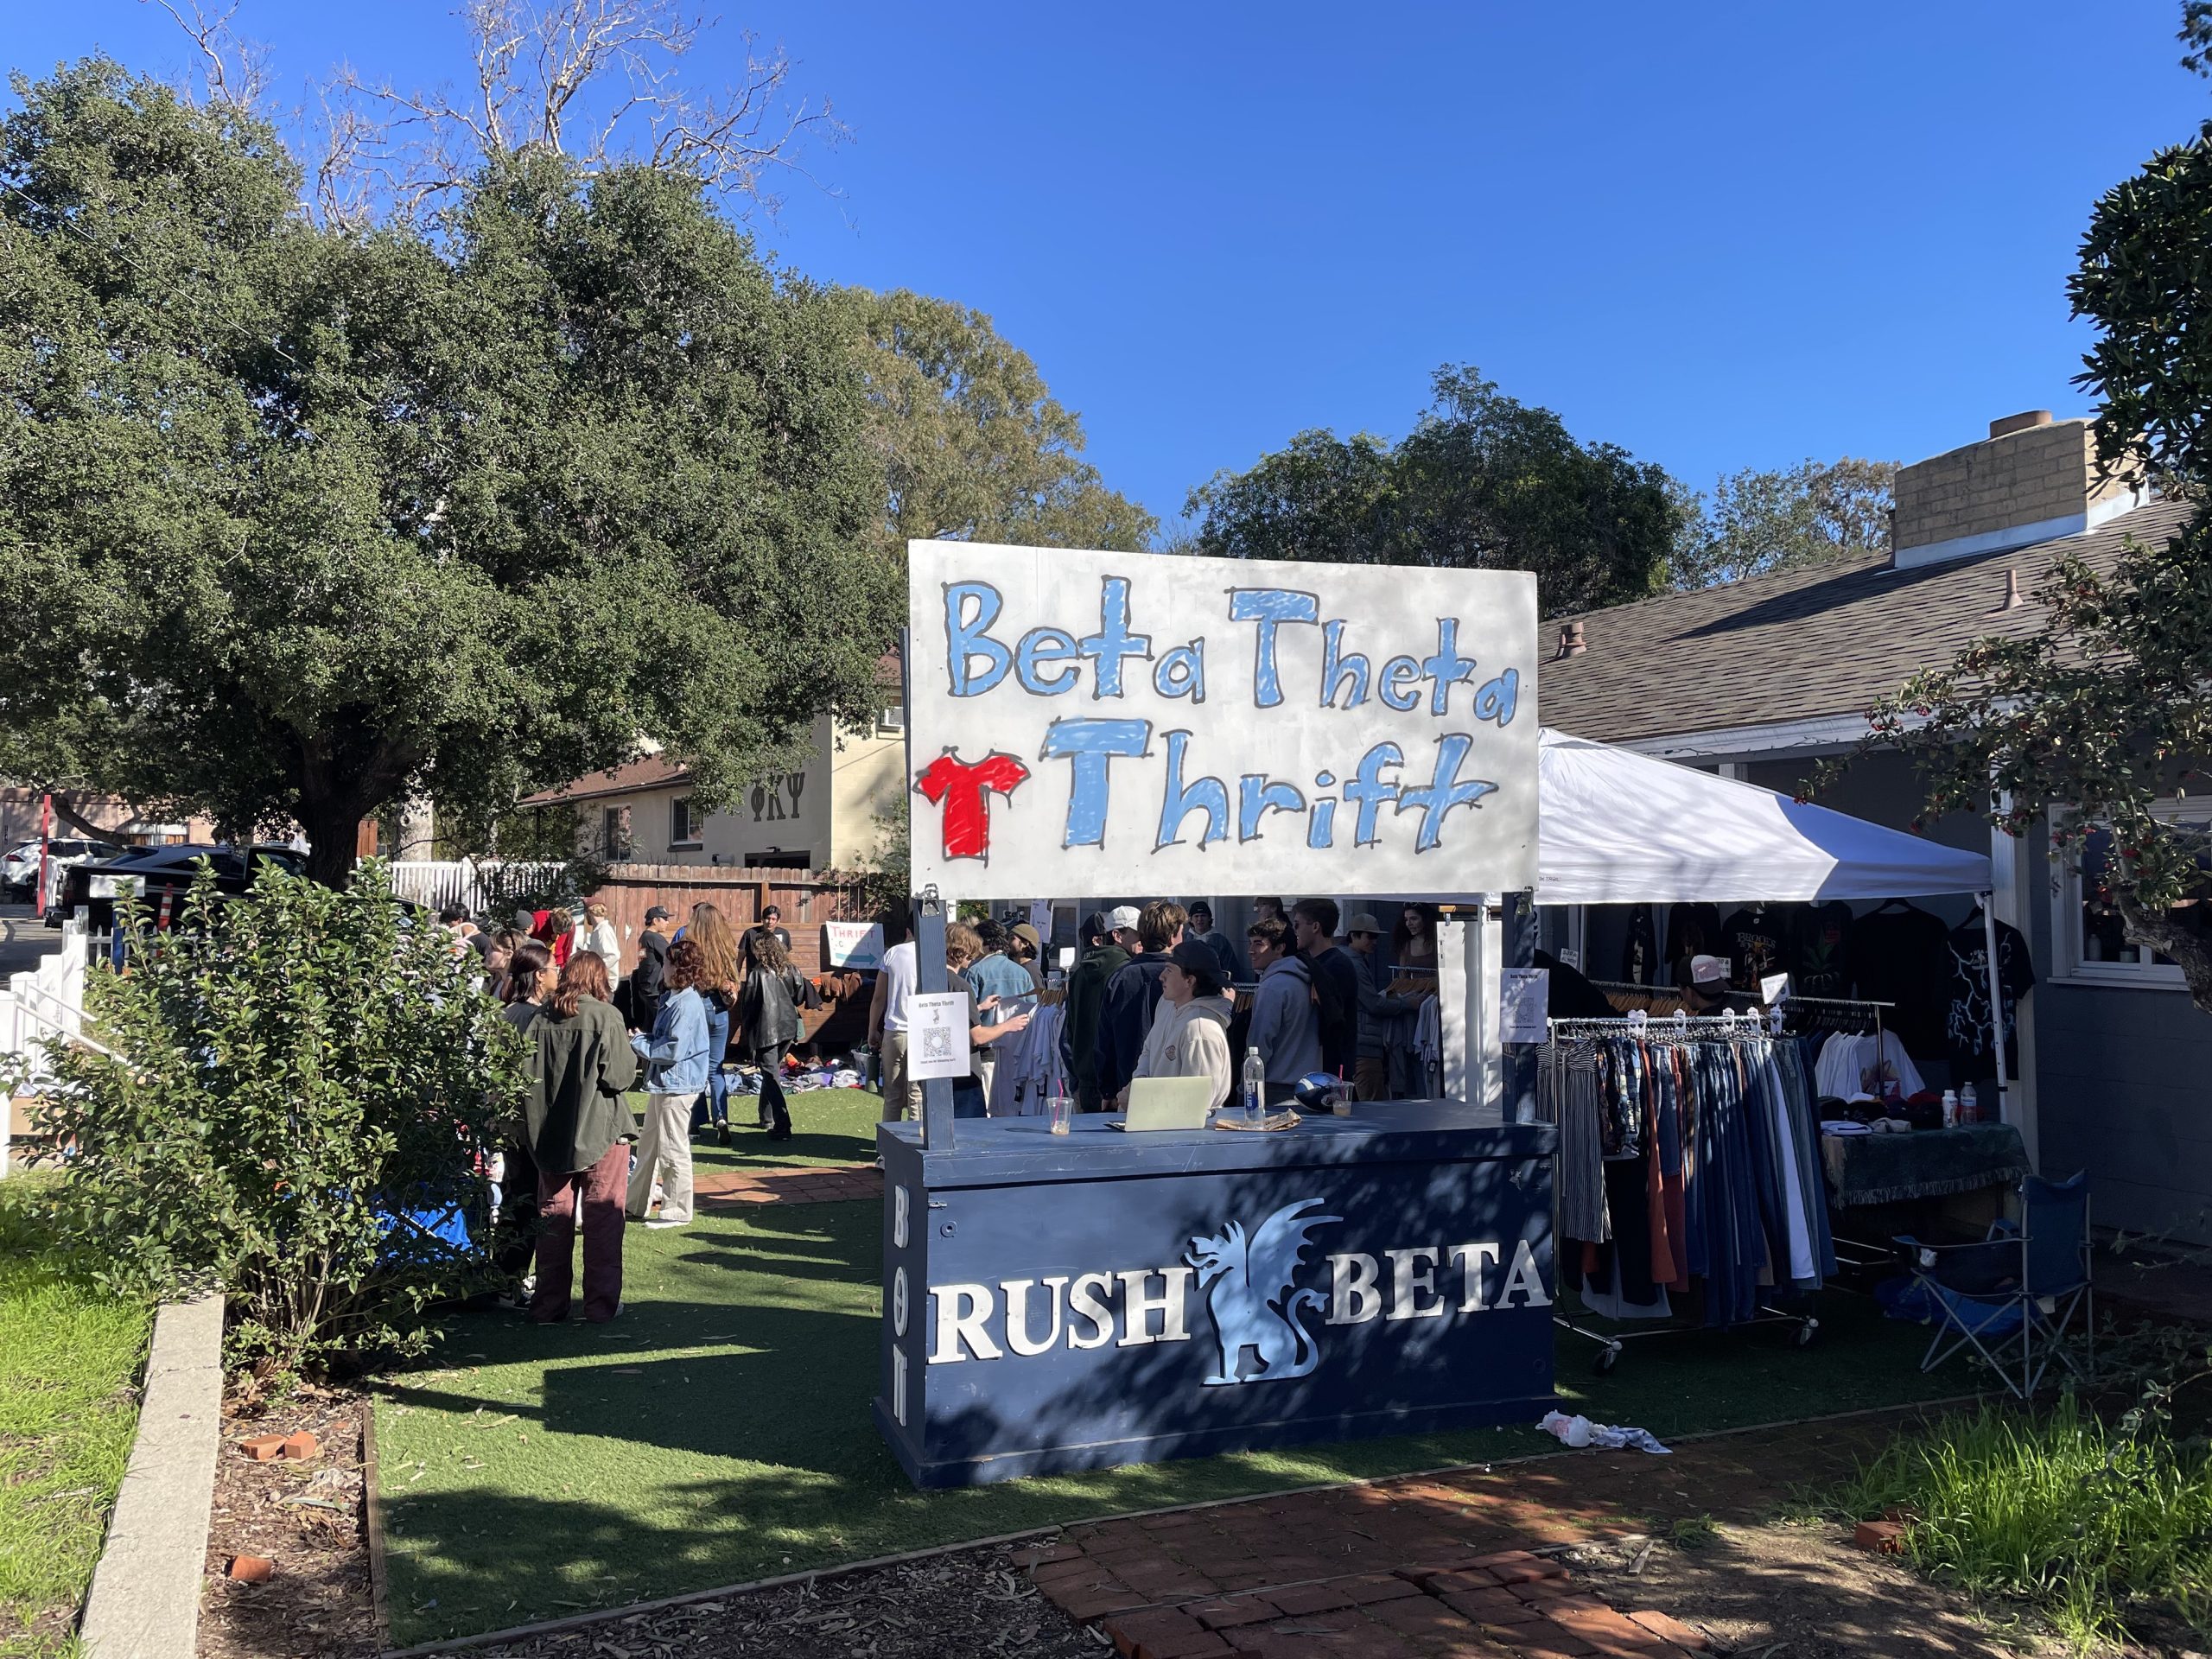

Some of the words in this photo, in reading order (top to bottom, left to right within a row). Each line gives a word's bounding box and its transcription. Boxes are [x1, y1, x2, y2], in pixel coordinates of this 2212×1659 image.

[942, 575, 1207, 704] Beta
[1224, 587, 1519, 727] Theta
[1039, 716, 1499, 855] Thrift
[830, 925, 875, 938] THRIFT
[927, 1265, 1196, 1365] RUSH
[1325, 1239, 1553, 1325] BETA
